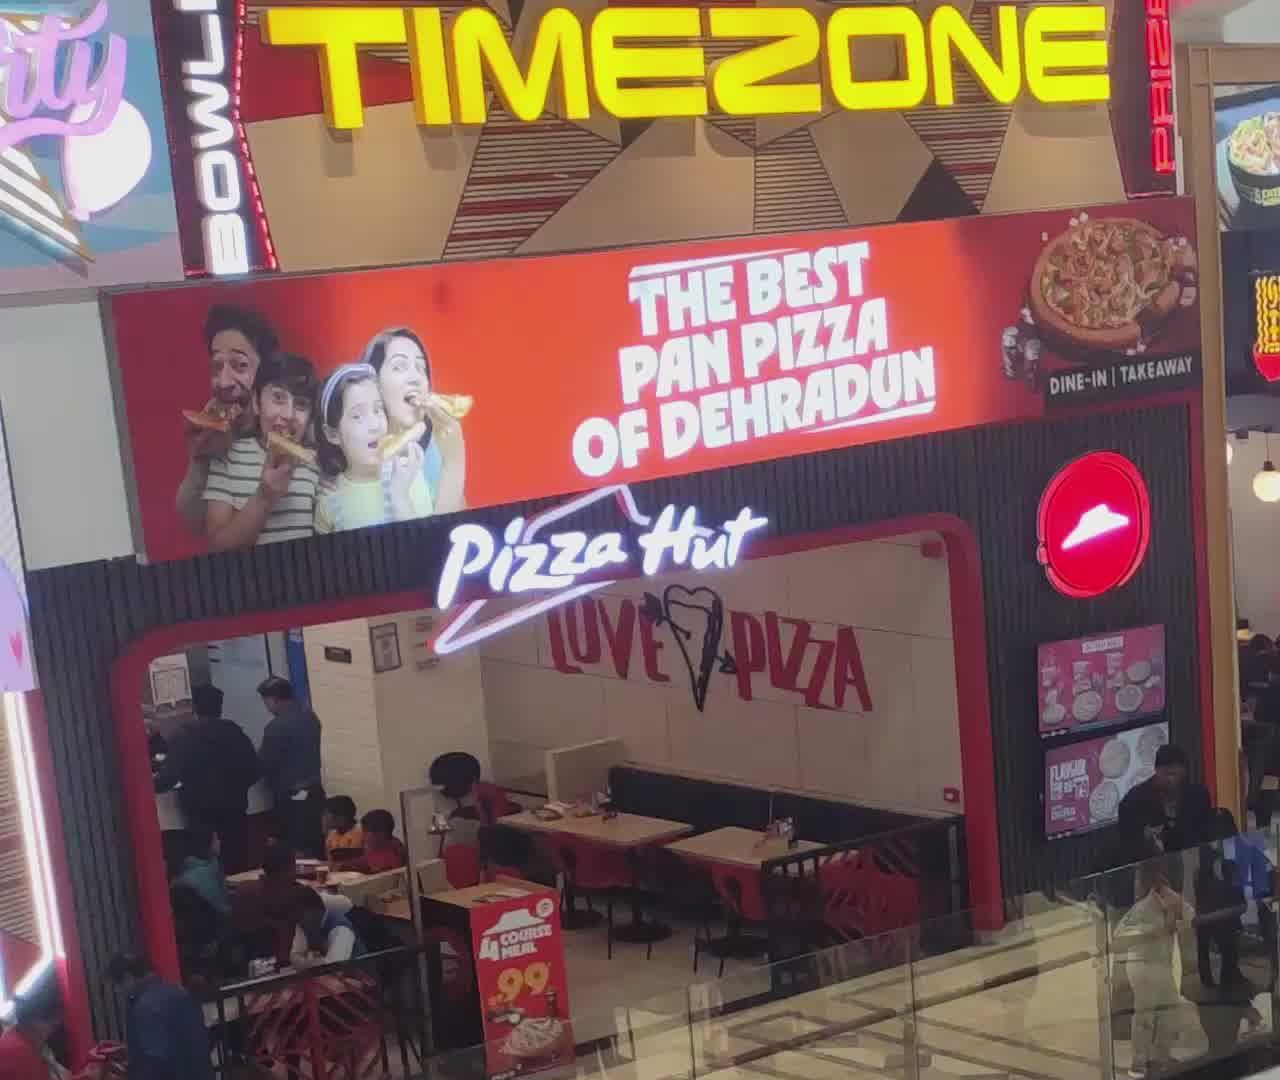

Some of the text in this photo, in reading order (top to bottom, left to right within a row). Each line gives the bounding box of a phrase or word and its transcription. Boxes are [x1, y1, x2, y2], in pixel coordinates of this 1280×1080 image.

[267, 2, 1110, 130] TIMEZONE
[628, 241, 870, 337] THE BEST
[619, 298, 889, 404] PAN PIZZA
[1049, 355, 1194, 396] DINE-IN TAKEAWAY
[572, 346, 936, 478] OF DEHRADUN
[437, 505, 769, 610] Pizza Hut
[729, 609, 874, 713] PIZZA
